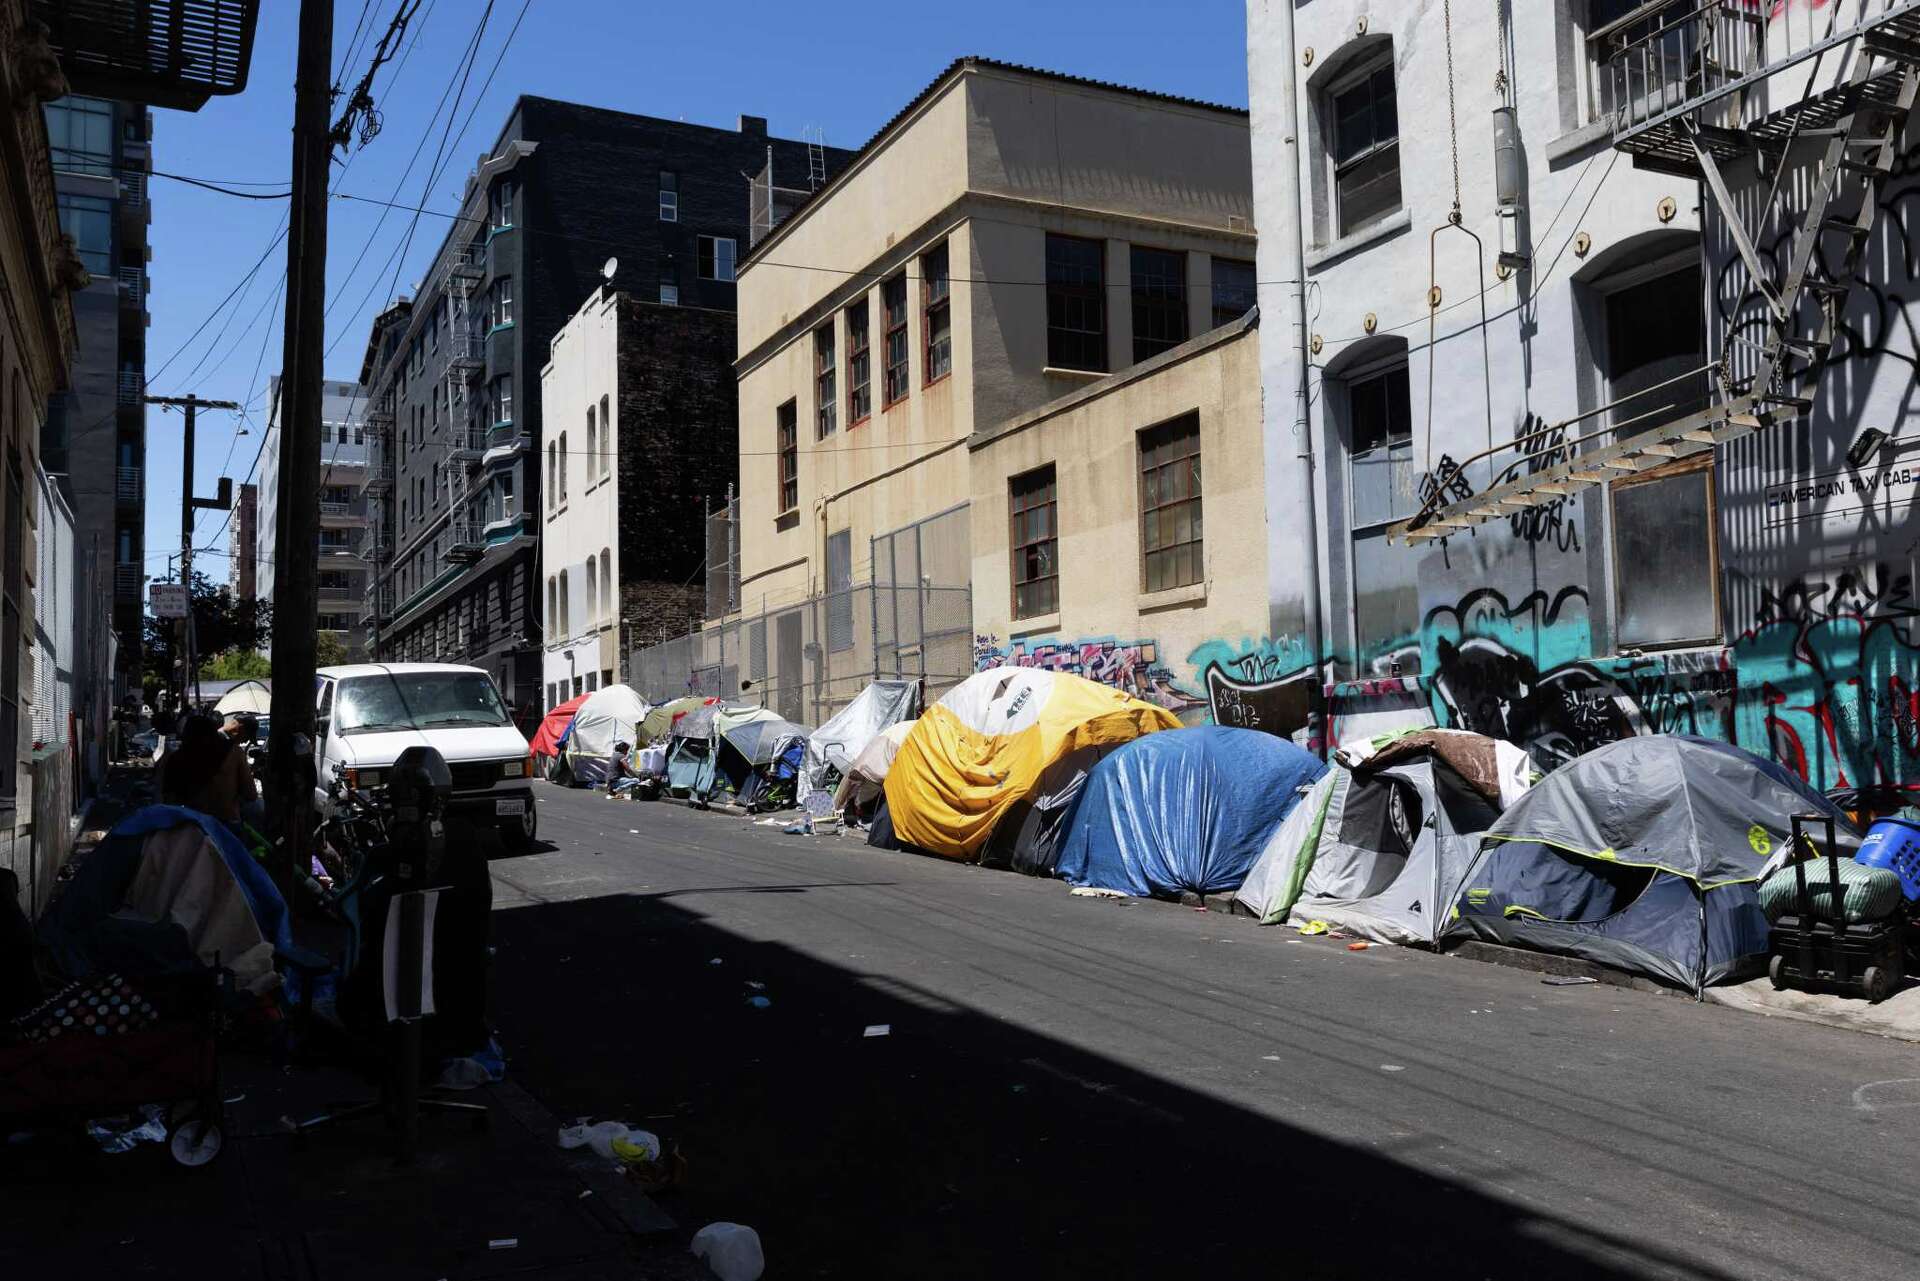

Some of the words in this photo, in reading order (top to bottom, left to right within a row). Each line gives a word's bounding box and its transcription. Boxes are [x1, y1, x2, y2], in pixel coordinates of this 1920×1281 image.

[1780, 480, 1845, 504] AMERICAN
[1850, 474, 1879, 493] TAXI
[1882, 469, 1911, 487] CAB
